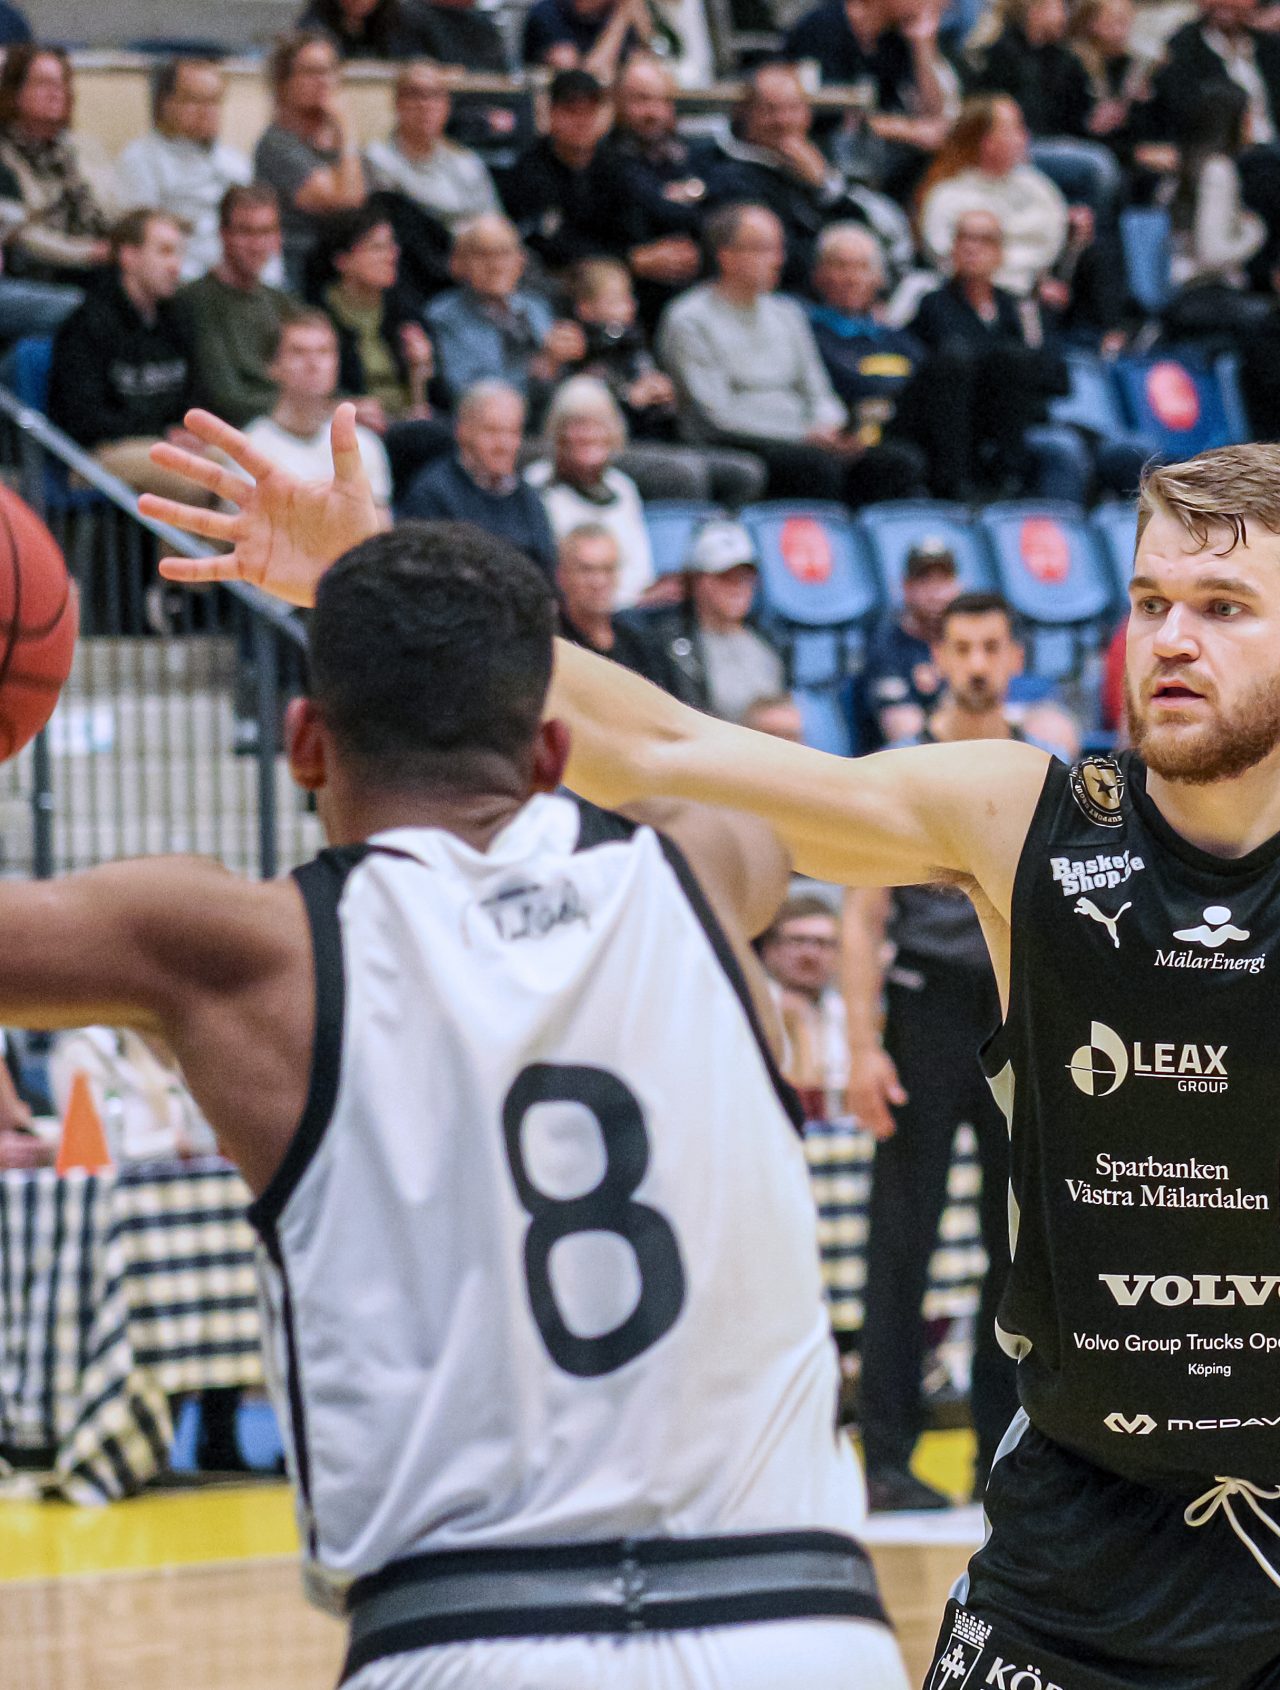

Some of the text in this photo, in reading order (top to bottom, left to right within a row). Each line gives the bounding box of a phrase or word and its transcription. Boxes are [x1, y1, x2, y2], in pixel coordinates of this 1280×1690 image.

[1154, 949, 1266, 974] MälarEnergi
[1133, 1041, 1228, 1075] LEAX
[1177, 1080, 1229, 1093] GROUP
[1096, 1152, 1230, 1183] Sparbanken
[1065, 1178, 1270, 1210] Västra Mälardalen
[502, 1062, 687, 1380] 8
[1073, 1332, 1119, 1351] Volvo
[1125, 1334, 1182, 1355] Group
[1186, 1333, 1244, 1350] Trucks
[1188, 1363, 1232, 1377] Köping
